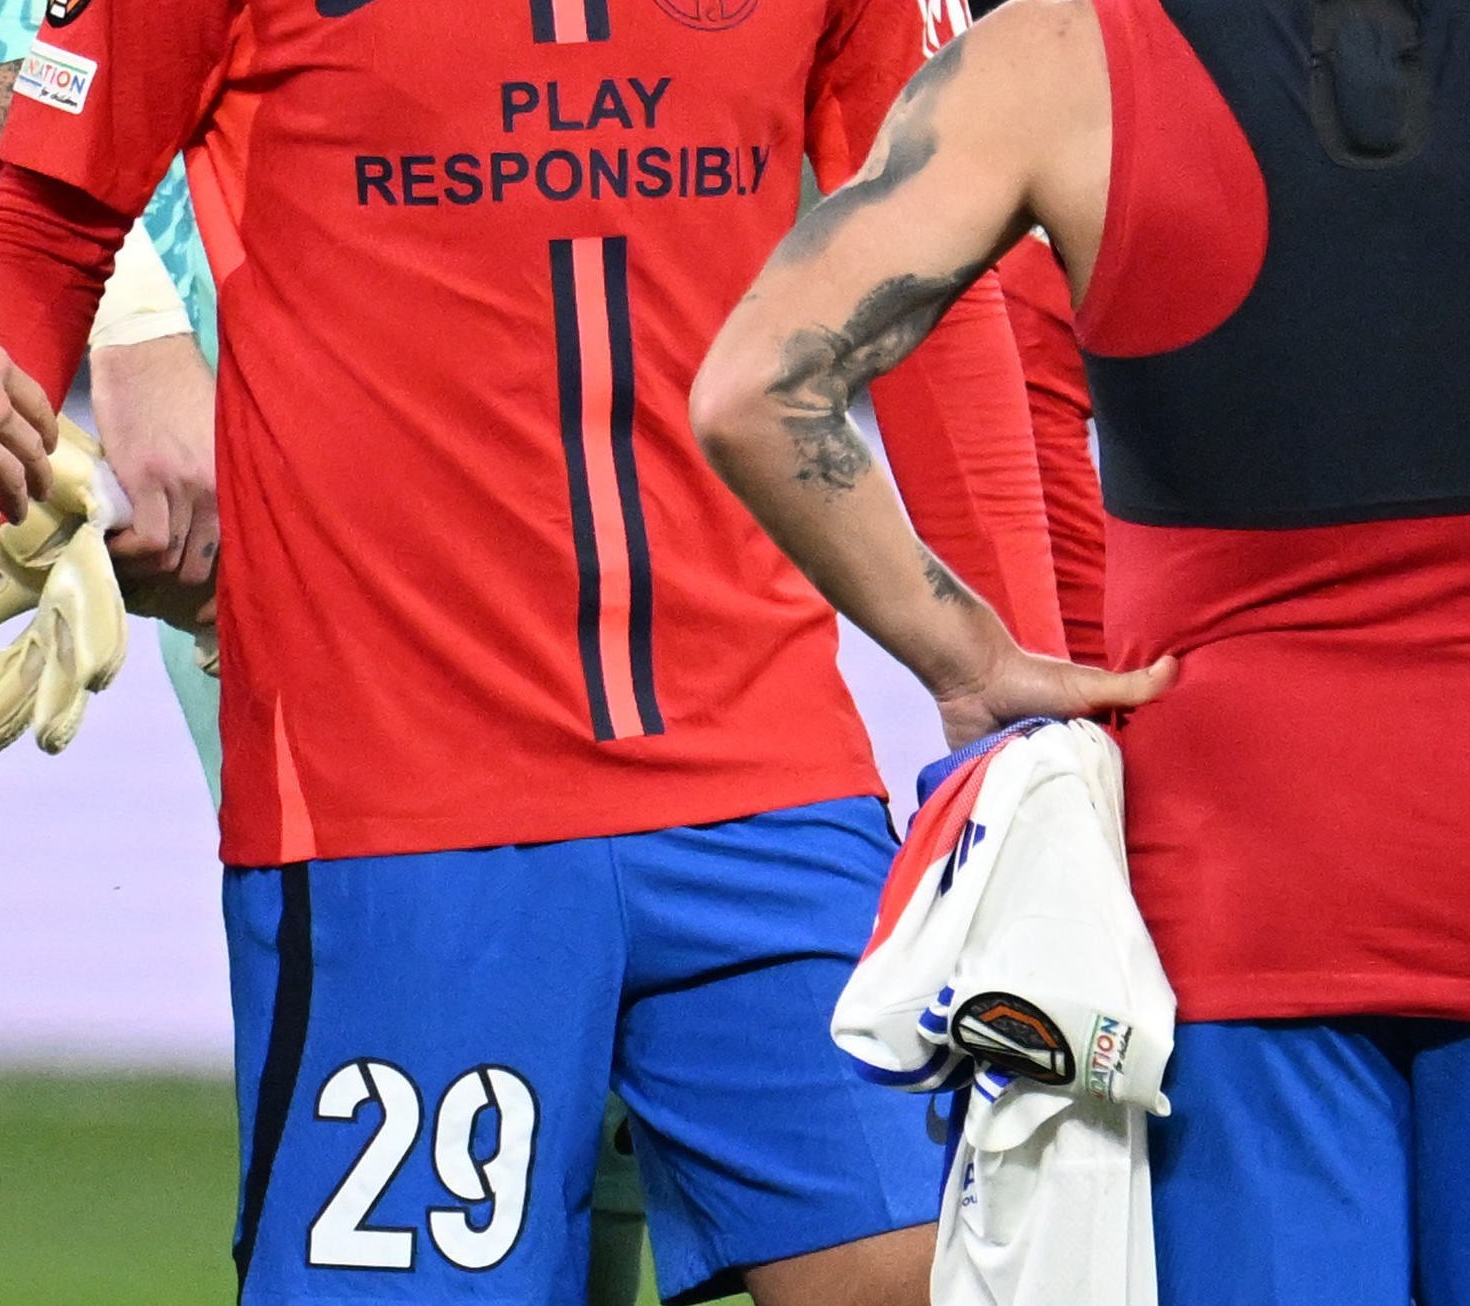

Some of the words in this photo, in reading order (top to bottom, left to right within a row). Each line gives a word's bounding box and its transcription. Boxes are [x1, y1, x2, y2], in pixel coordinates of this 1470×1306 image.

[499, 76, 672, 134] PLAY
[354, 142, 771, 207] RESPONSIBLY
[305, 1056, 541, 1273] 29
